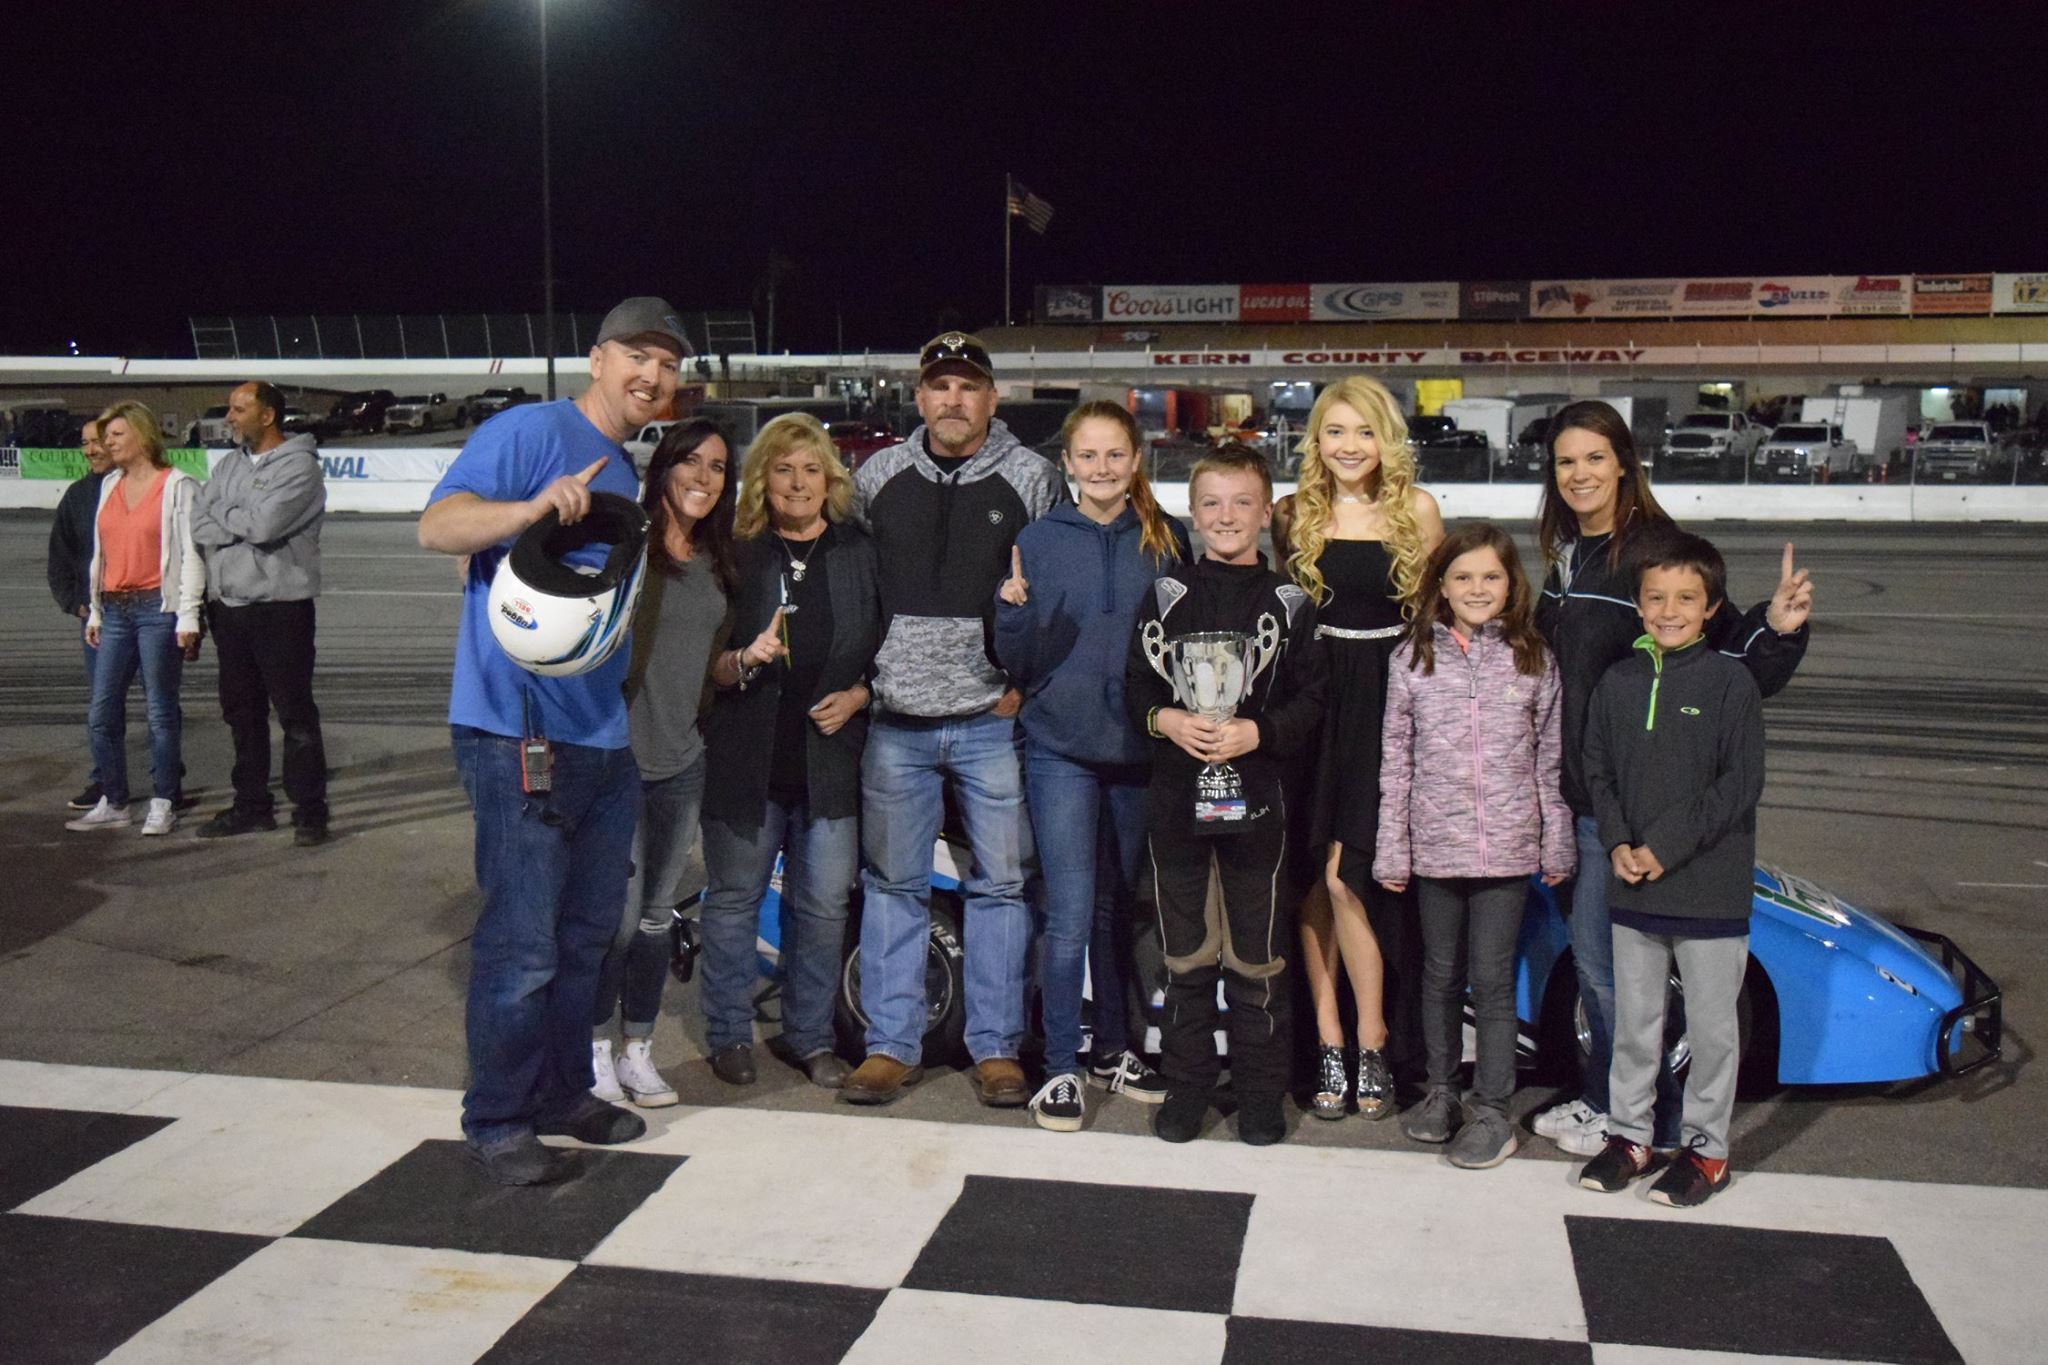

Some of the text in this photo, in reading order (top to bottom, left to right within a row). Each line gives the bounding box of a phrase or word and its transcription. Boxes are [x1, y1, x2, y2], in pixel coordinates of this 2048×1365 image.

[1108, 290, 1174, 315] Coors
[1176, 297, 1234, 314] LIGHT
[1243, 296, 1306, 309] LUCAS OIL
[1154, 349, 1646, 365] KERN COUNTY RACEWAY
